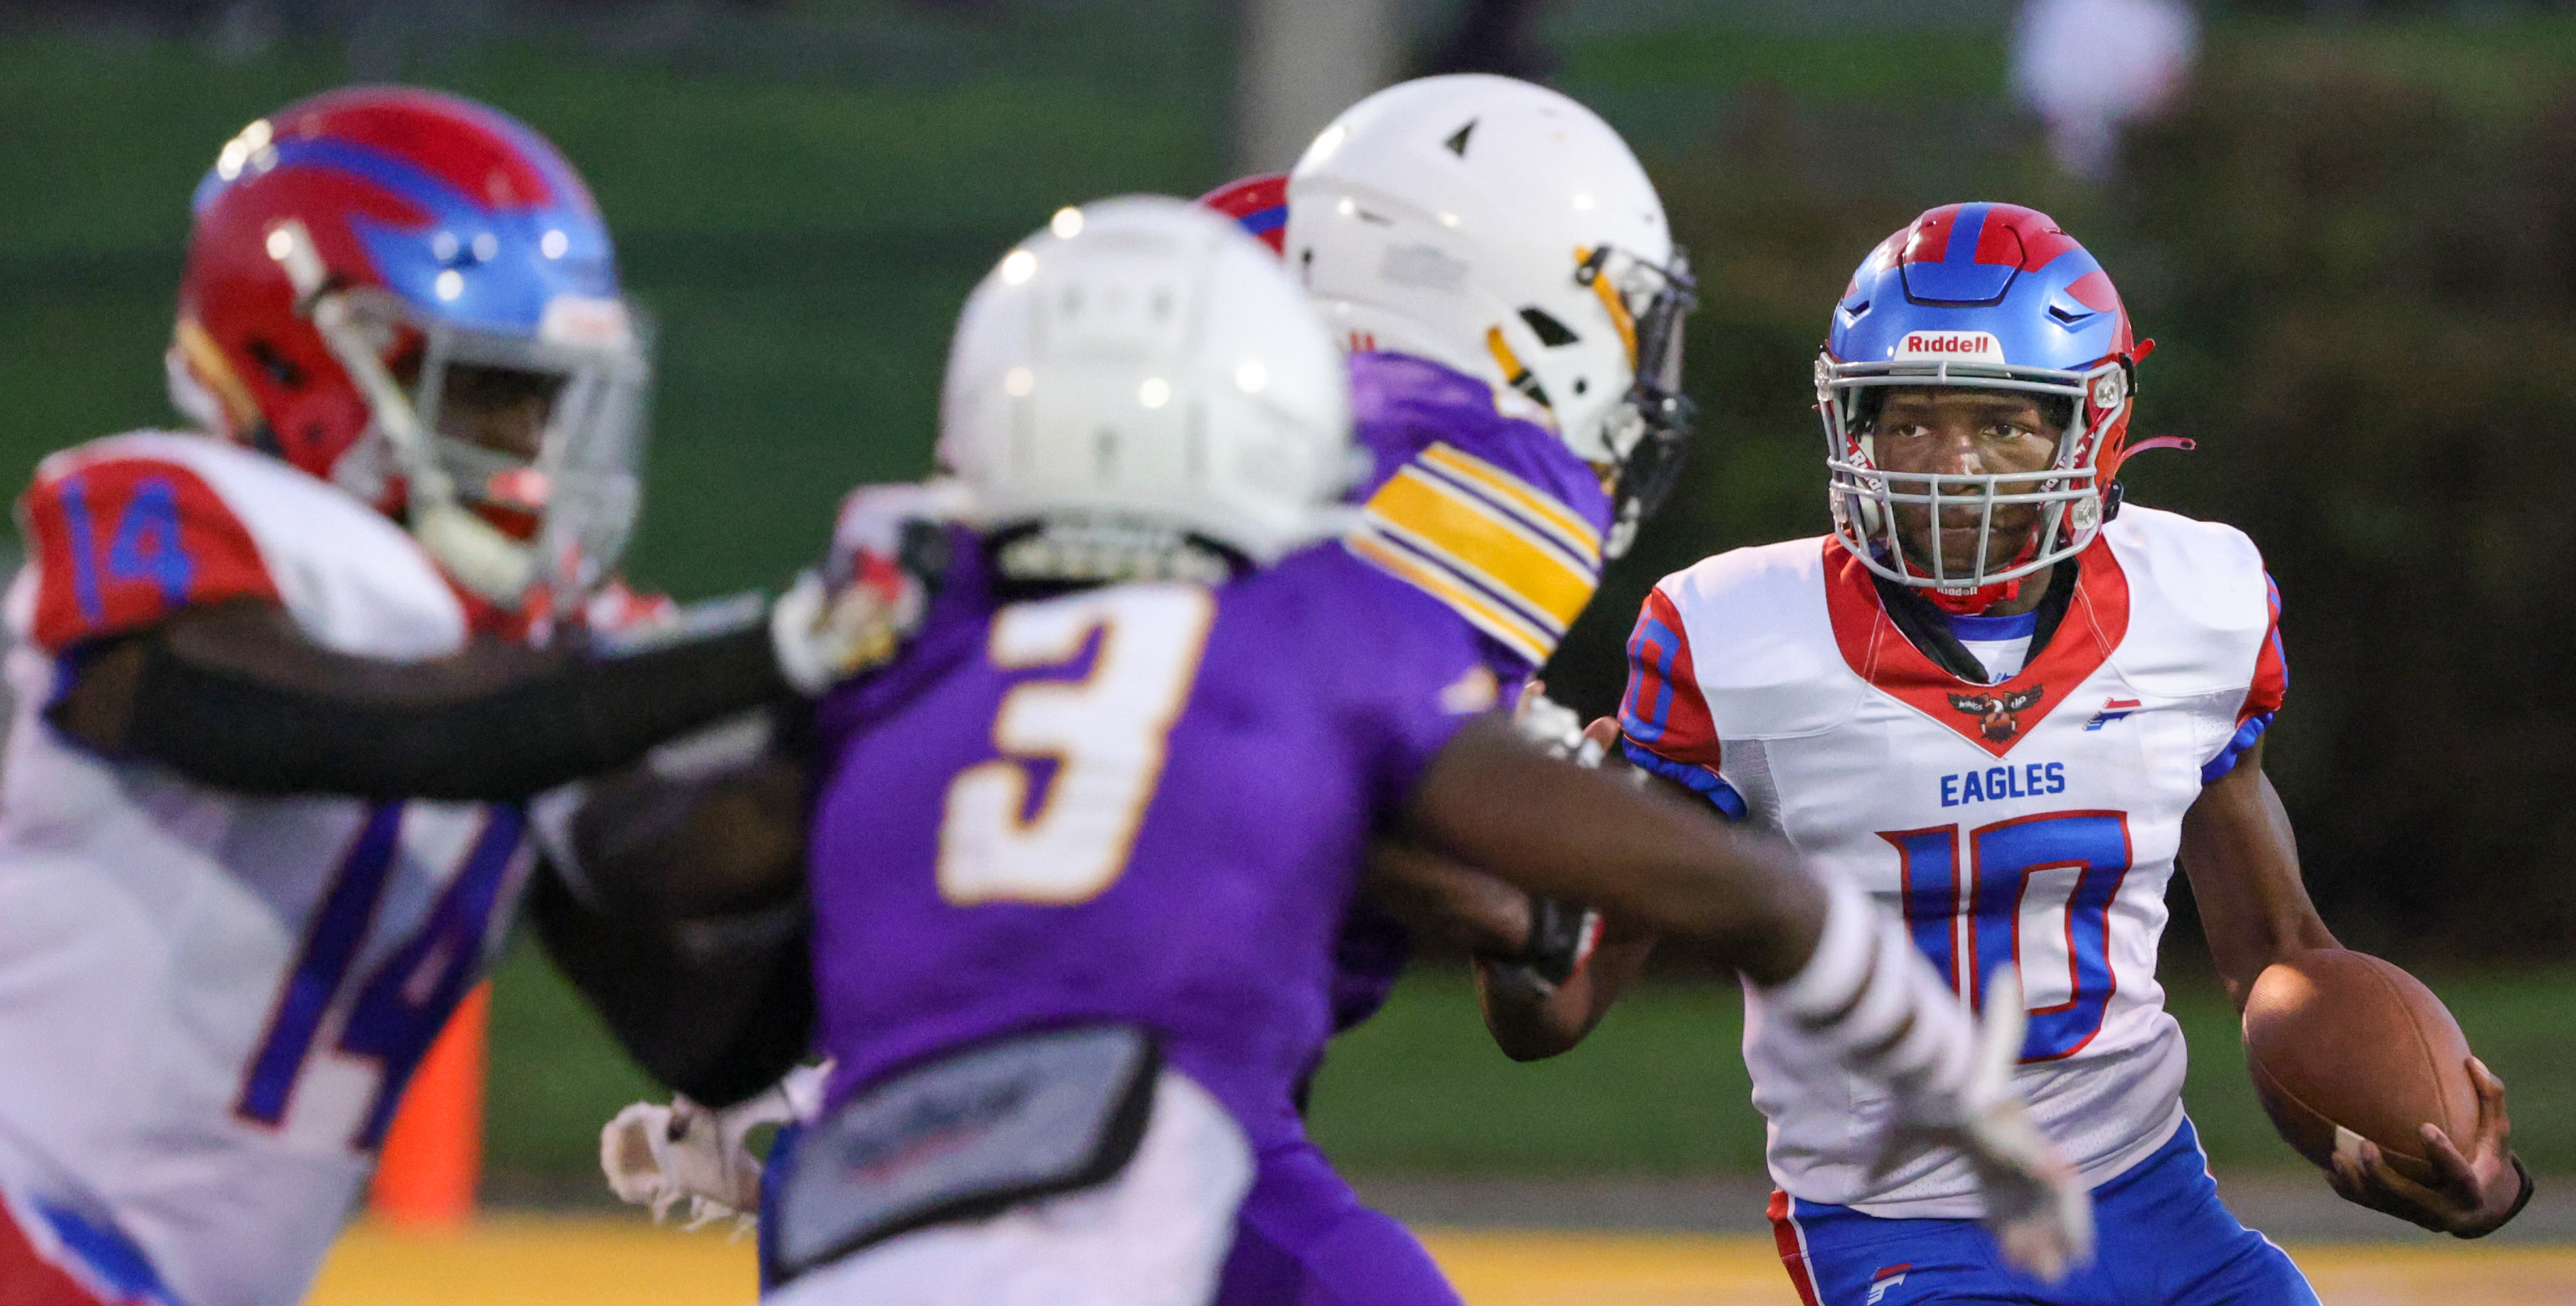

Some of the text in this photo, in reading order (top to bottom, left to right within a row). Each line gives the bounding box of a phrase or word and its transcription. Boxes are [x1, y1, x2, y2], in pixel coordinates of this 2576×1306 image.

[1908, 336, 1988, 353] Riddell
[60, 474, 191, 626] 14
[935, 585, 1217, 906] 3
[1941, 761, 2066, 807] EAGLES
[228, 798, 527, 1153] 14
[1874, 810, 2133, 1064] 10
